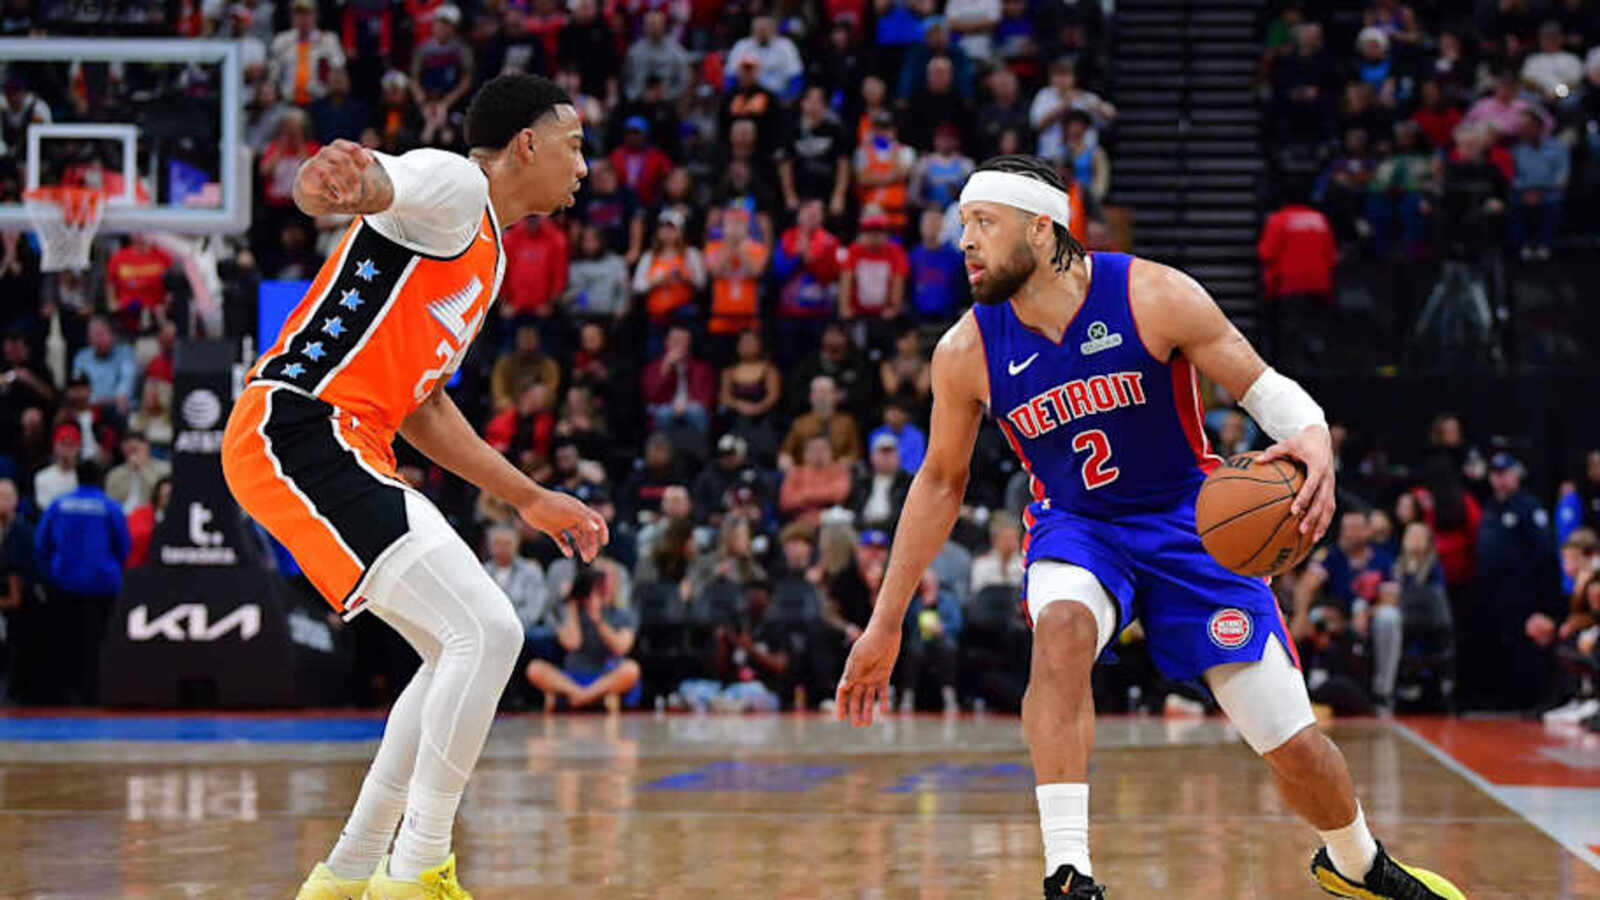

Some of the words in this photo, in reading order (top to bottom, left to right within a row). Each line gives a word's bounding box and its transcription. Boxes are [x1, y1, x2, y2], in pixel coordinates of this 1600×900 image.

[1007, 371, 1146, 439] DETROIT
[1072, 429, 1120, 490] 2
[127, 603, 261, 641] KIA
